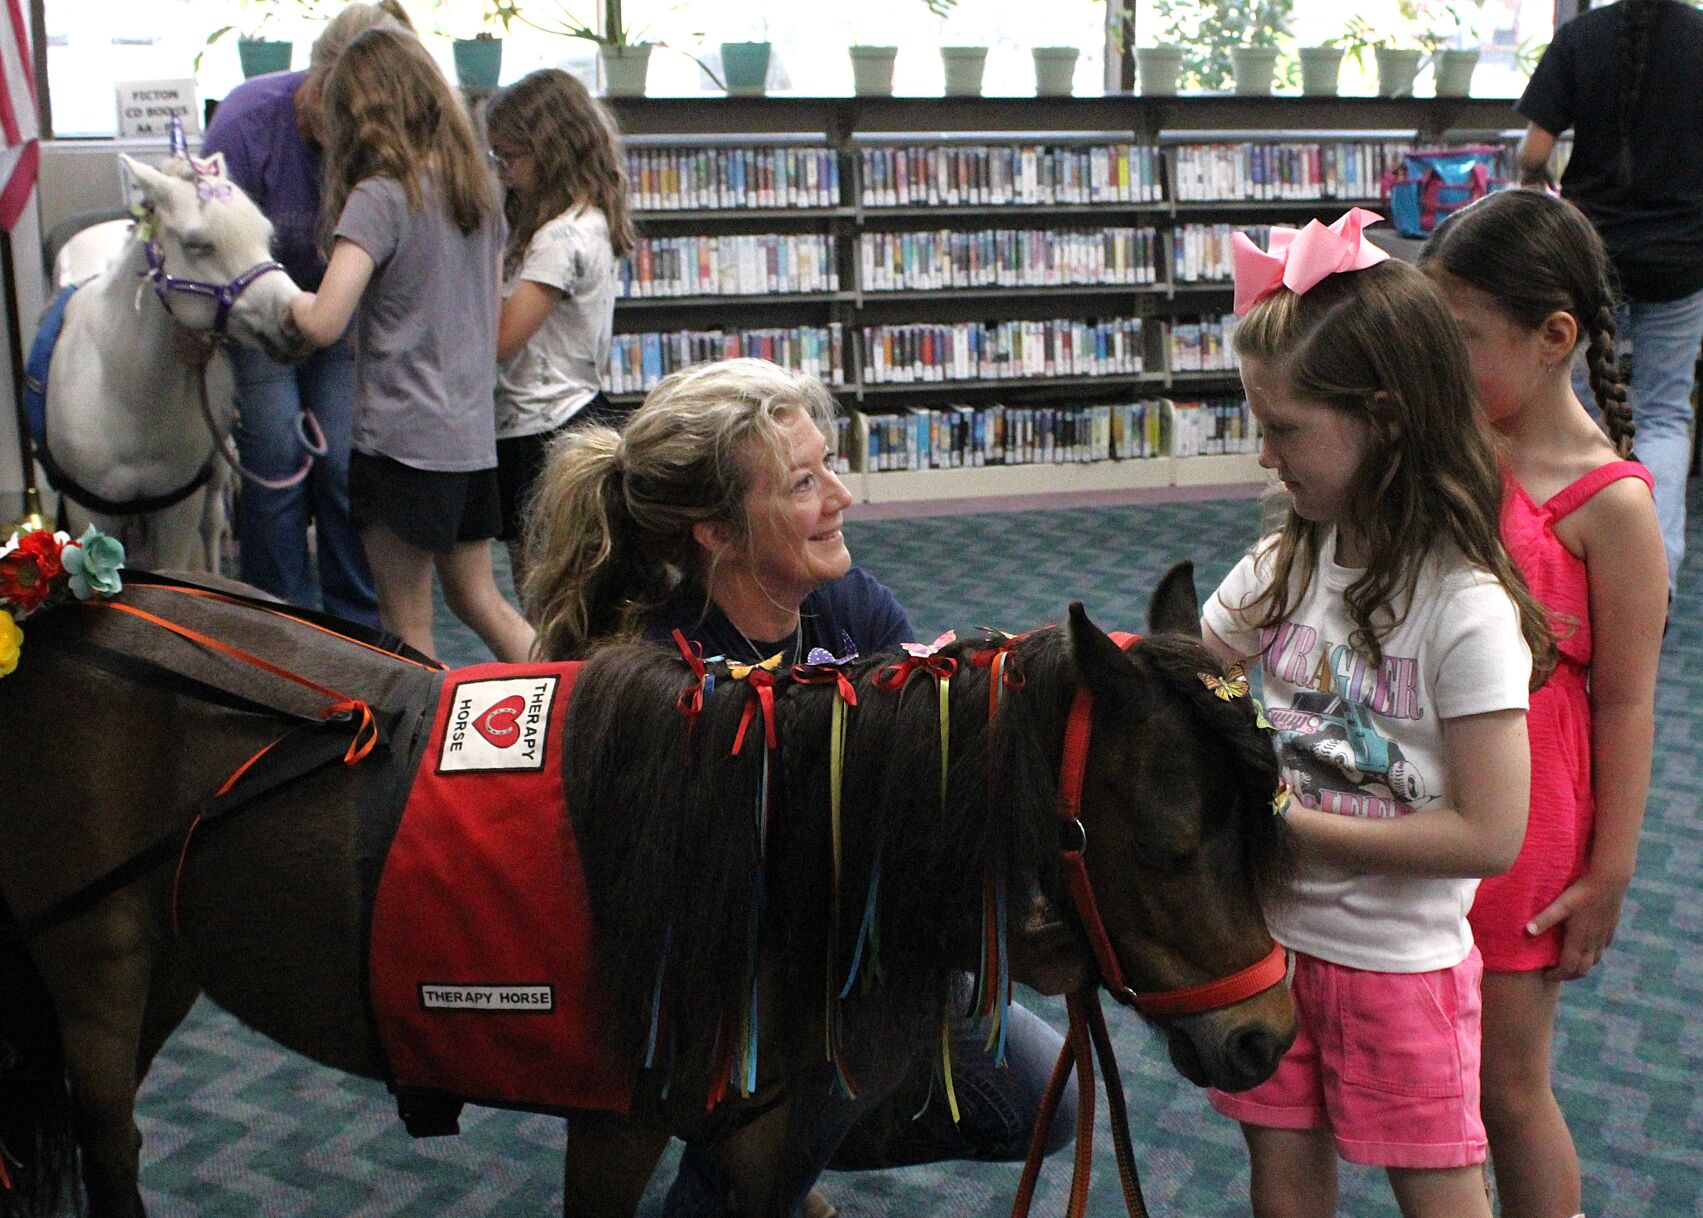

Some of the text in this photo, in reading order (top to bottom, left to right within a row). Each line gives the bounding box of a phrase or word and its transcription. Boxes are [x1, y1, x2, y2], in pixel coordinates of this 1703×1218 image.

[450, 699, 472, 752] HORSE
[522, 683, 547, 760] THERAPY
[425, 991, 549, 1004] THERAPY HORSE
